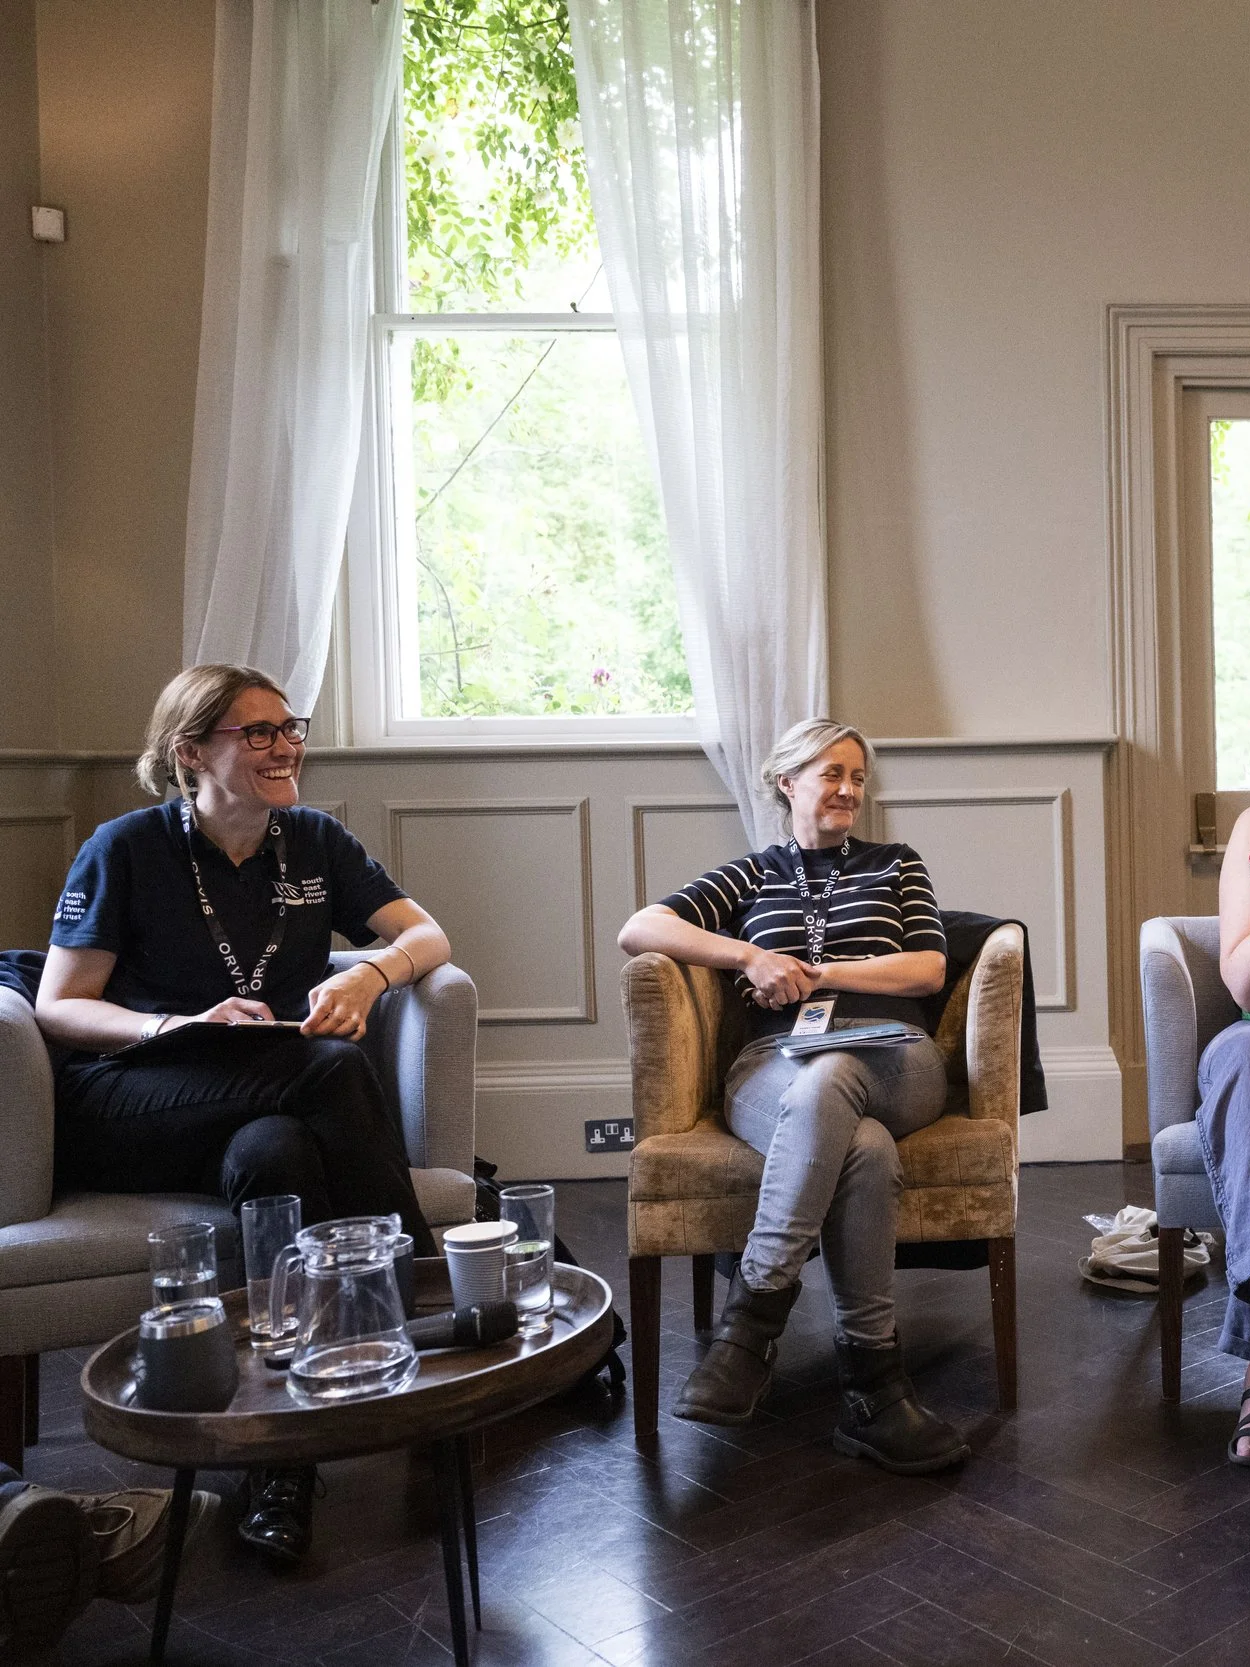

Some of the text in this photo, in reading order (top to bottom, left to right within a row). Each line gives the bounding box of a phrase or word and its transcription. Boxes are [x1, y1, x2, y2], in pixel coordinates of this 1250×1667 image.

[301, 876, 324, 885] south
[304, 890, 327, 898] rivers
[795, 866, 810, 898] ORVIS
[821, 869, 840, 899] ORVIS
[63, 905, 86, 913] rivers
[306, 896, 326, 904] trust
[812, 918, 826, 965] ORVIS
[218, 943, 250, 996] ORVIS
[250, 944, 278, 991] ORVIS
